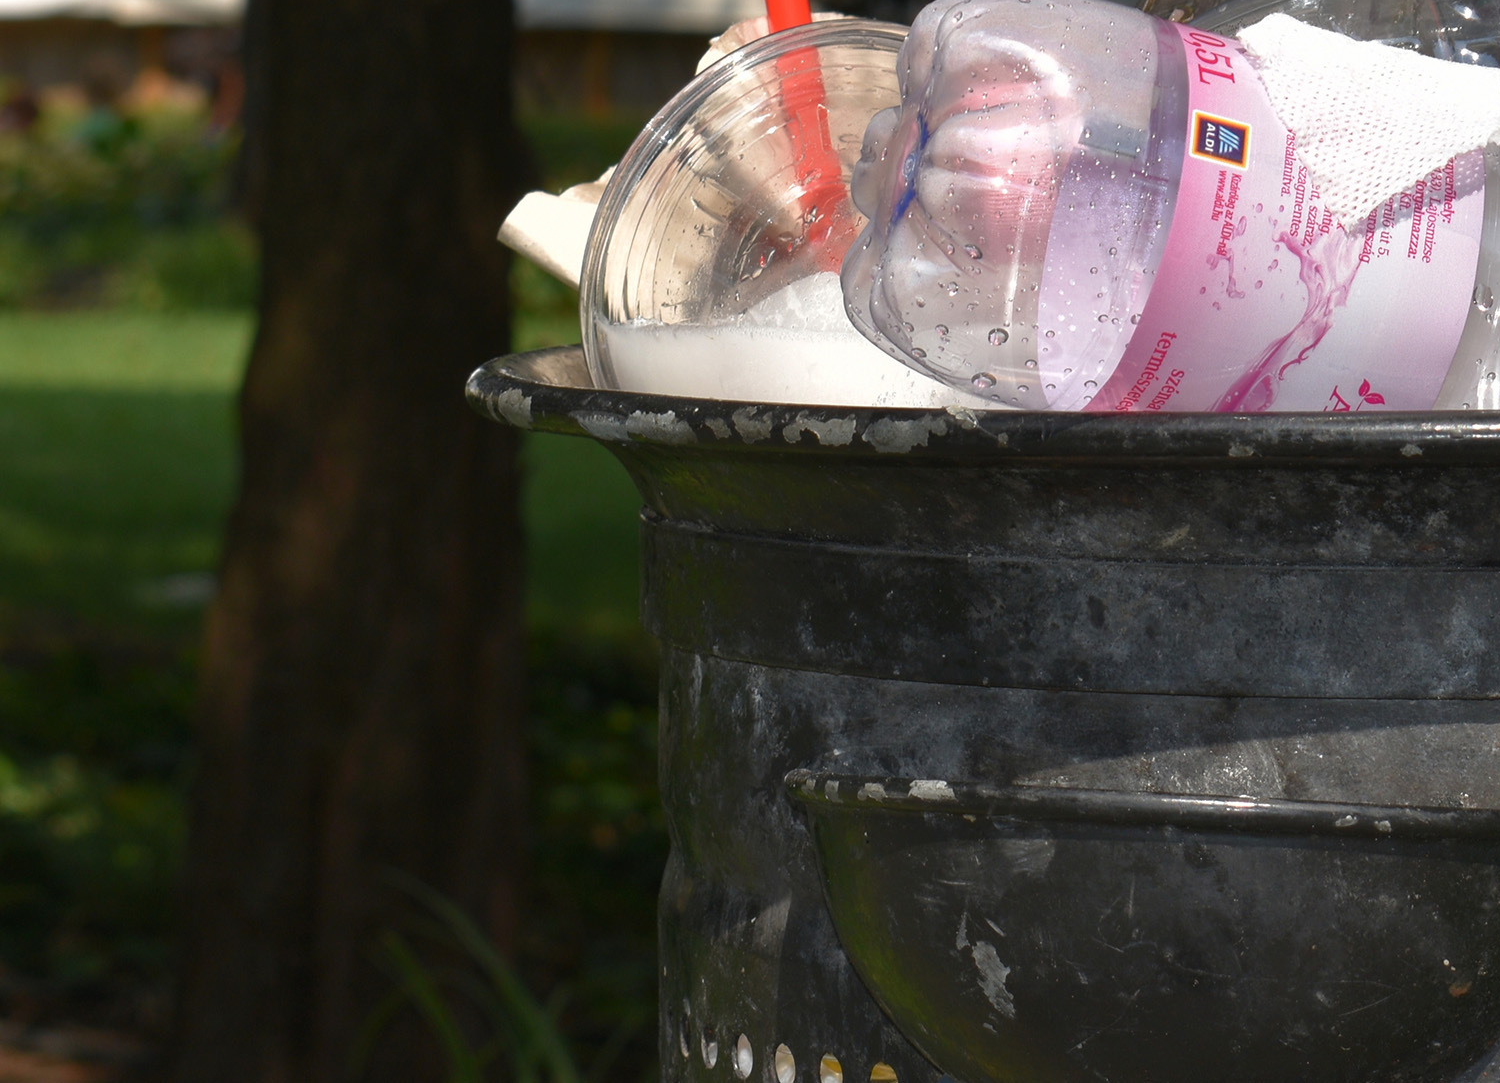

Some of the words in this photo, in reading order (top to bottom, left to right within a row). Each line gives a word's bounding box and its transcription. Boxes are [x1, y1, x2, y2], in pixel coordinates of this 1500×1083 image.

[1184, 32, 1236, 86] 0,5L
[1204, 122, 1217, 152] ALDI
[1210, 170, 1227, 222] www.aldi.hu
[1224, 172, 1243, 211] Kizárólag
[1289, 165, 1308, 237] szagmentes
[1399, 191, 1412, 211] Kft.
[1216, 219, 1234, 257] ALDI-nál
[1301, 205, 1319, 247] száraz,
[1358, 207, 1378, 264] arország
[1379, 230, 1391, 247] út
[1407, 179, 1428, 260] forgalmazza:
[1421, 197, 1442, 264] Lajosmizse
[1377, 247, 1391, 259] 5.
[1115, 331, 1178, 413] természetes
[1145, 368, 1185, 412] szénsa
